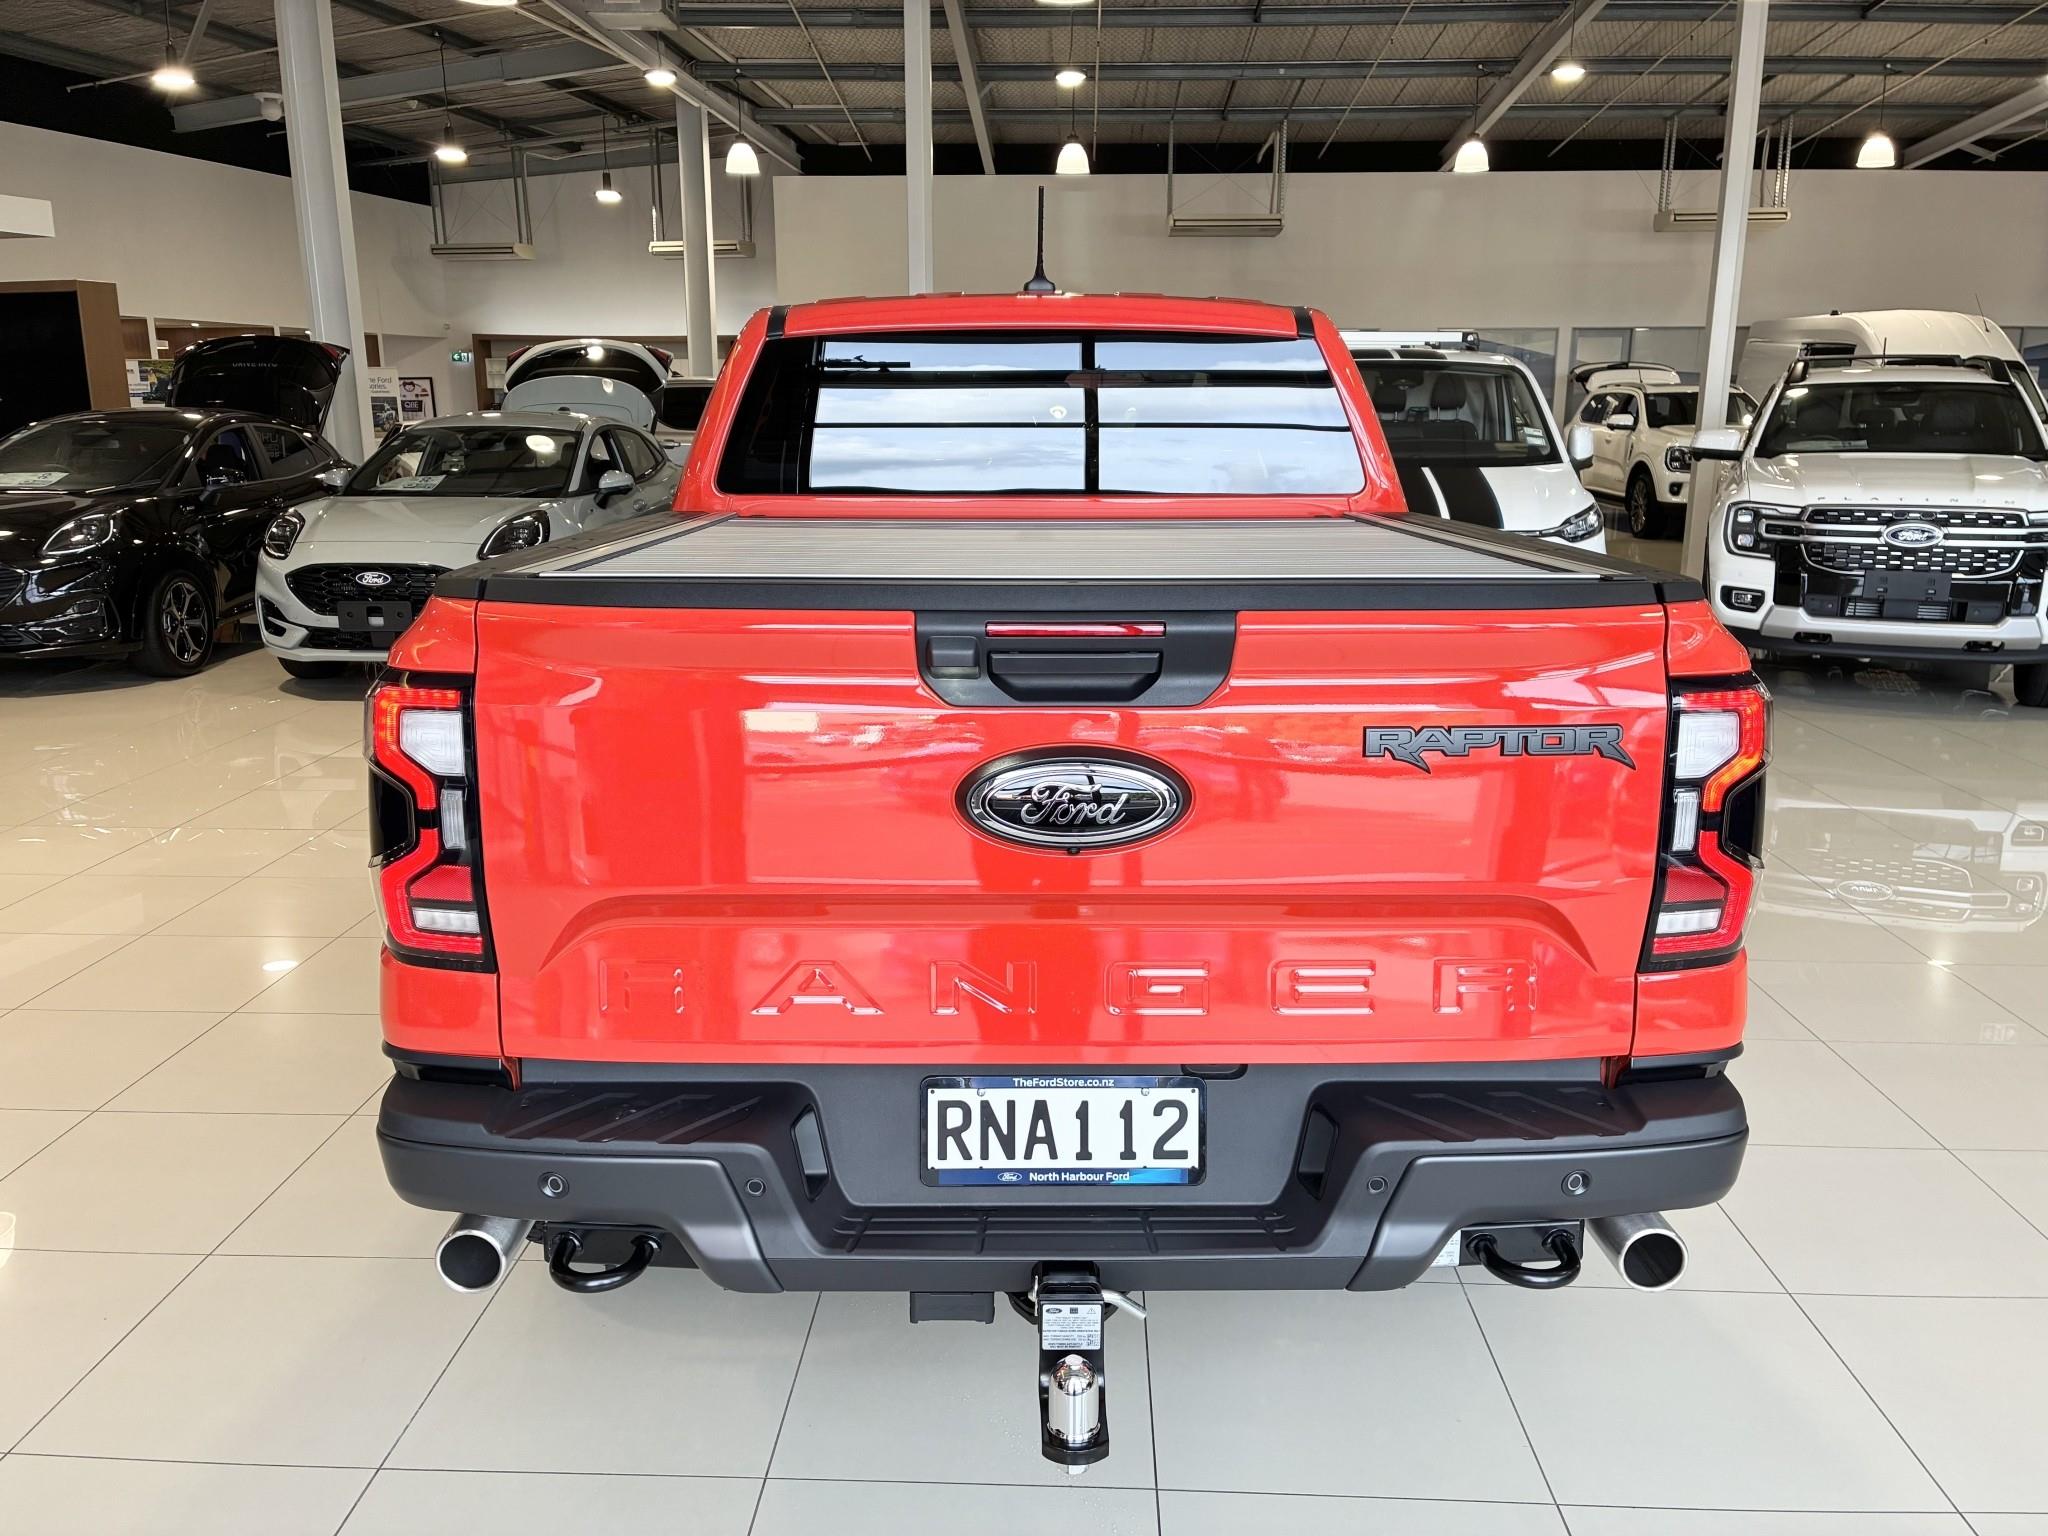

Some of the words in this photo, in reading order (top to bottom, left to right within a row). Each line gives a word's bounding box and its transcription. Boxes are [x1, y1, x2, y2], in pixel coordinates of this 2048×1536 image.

[377, 376, 392, 384] Ford
[1898, 530, 1930, 541] Ford
[362, 573, 384, 584] Ford
[1362, 724, 1636, 774] RAPTOR
[1021, 781, 1128, 824] Ford
[599, 958, 1538, 1016] RANGER
[1012, 1077, 1115, 1088] TheFordStore.co.nz
[937, 1099, 1189, 1160] RNA112
[1029, 1172, 1060, 1182] North
[1061, 1172, 1103, 1182] Harbour
[1105, 1172, 1130, 1182] Ford
